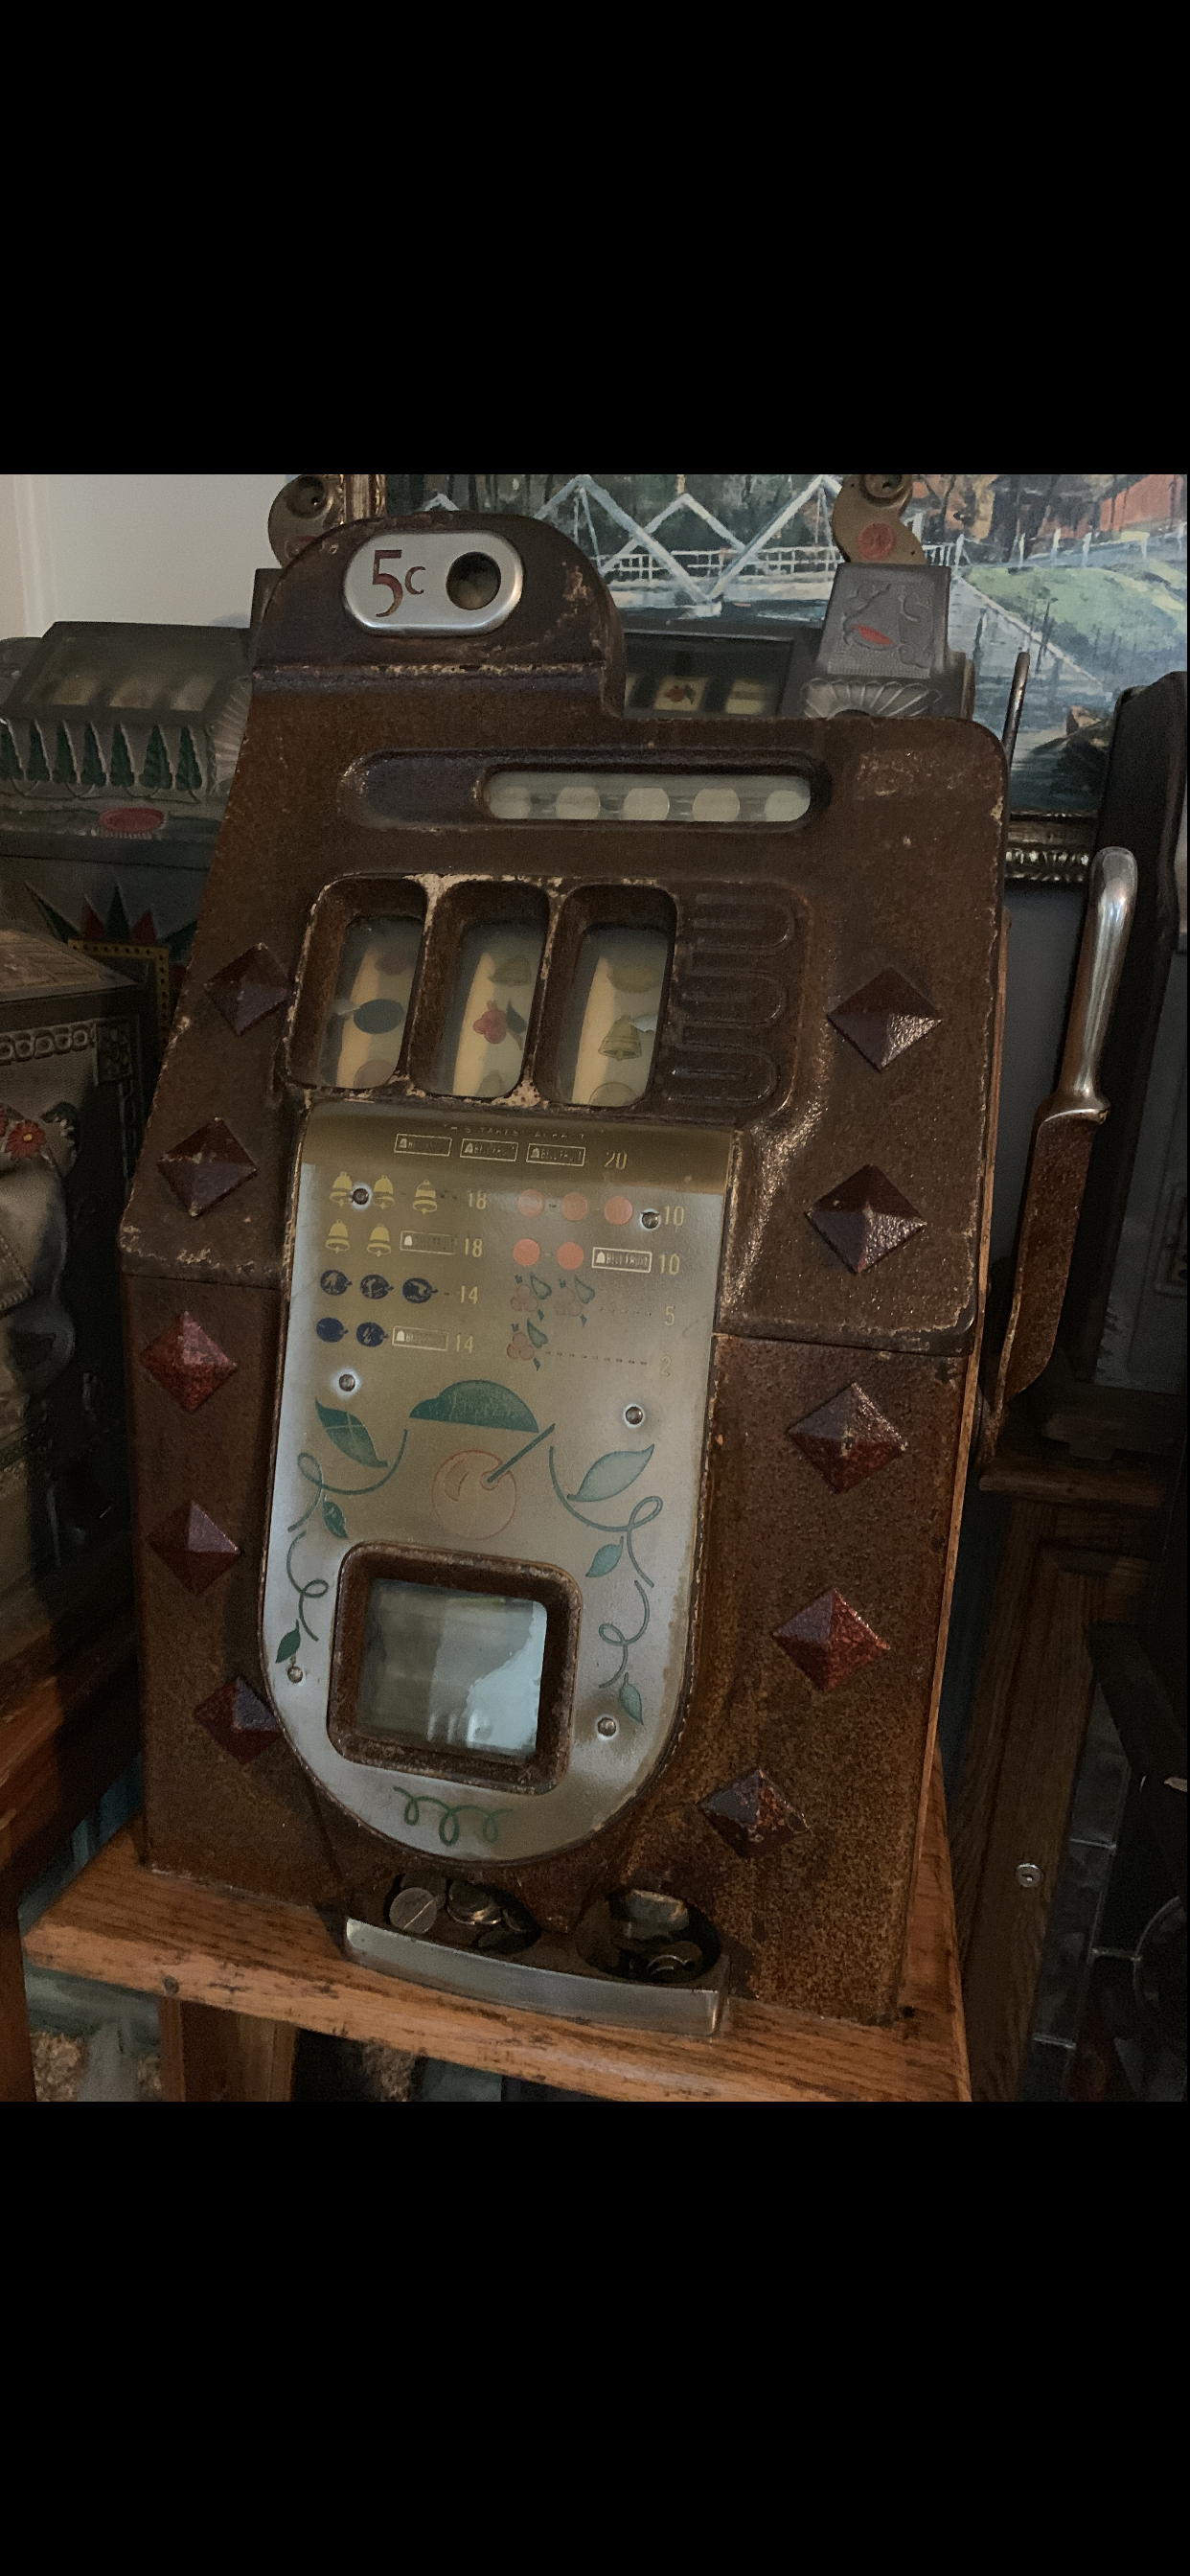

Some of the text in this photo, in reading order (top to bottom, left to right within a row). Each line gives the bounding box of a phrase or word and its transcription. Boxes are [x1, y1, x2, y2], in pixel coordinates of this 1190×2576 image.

[604, 1150, 628, 1171] 20
[467, 1189, 487, 1210] 18
[664, 1205, 685, 1227] 10
[464, 1237, 483, 1258] 18
[658, 1254, 680, 1276] 10
[460, 1285, 478, 1305] 14
[664, 1305, 676, 1326] 5
[455, 1333, 474, 1354] 14
[659, 1355, 673, 1377] 2
